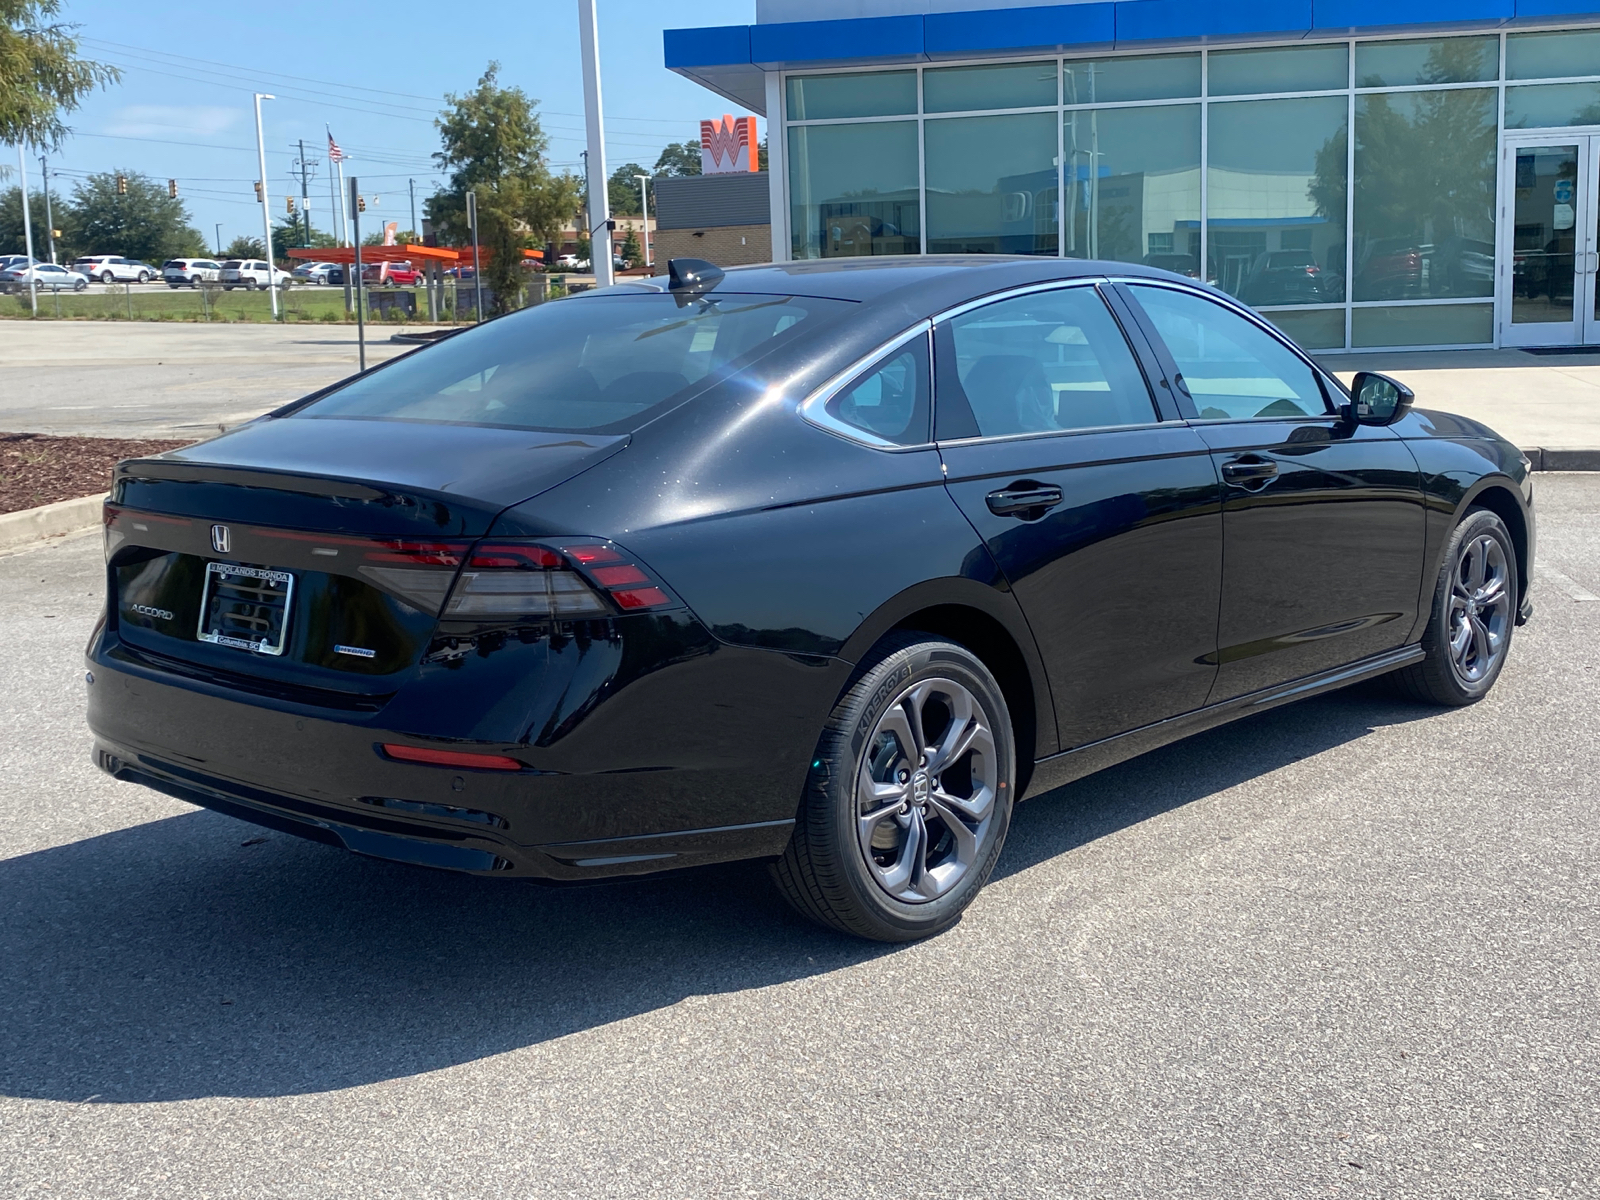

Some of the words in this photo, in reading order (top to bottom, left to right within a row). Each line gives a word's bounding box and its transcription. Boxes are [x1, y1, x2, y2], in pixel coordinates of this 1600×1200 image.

[217, 564, 255, 577] MIDLANDS
[258, 570, 288, 581] HONDA
[130, 603, 174, 620] ACCORD
[340, 646, 373, 656] HYBRID
[857, 670, 899, 738] KINERGY
